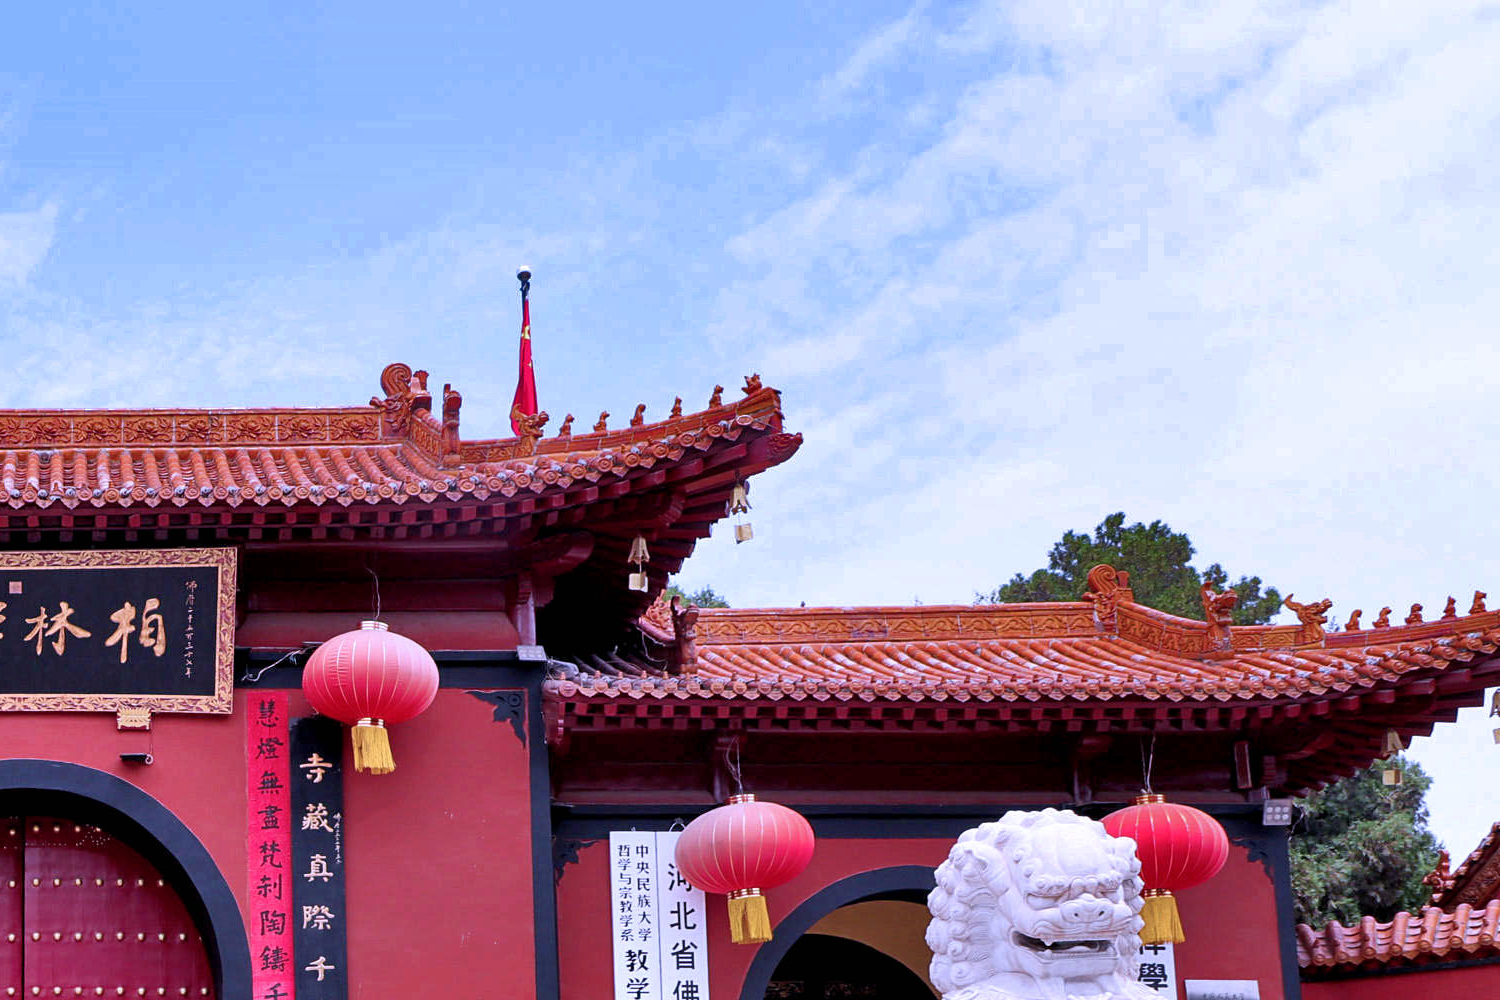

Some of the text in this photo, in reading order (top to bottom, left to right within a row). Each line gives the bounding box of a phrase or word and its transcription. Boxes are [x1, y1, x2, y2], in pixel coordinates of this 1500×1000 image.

[617, 844, 635, 942] 哲学与宗教学系
[636, 845, 652, 942] 中央民族大学
